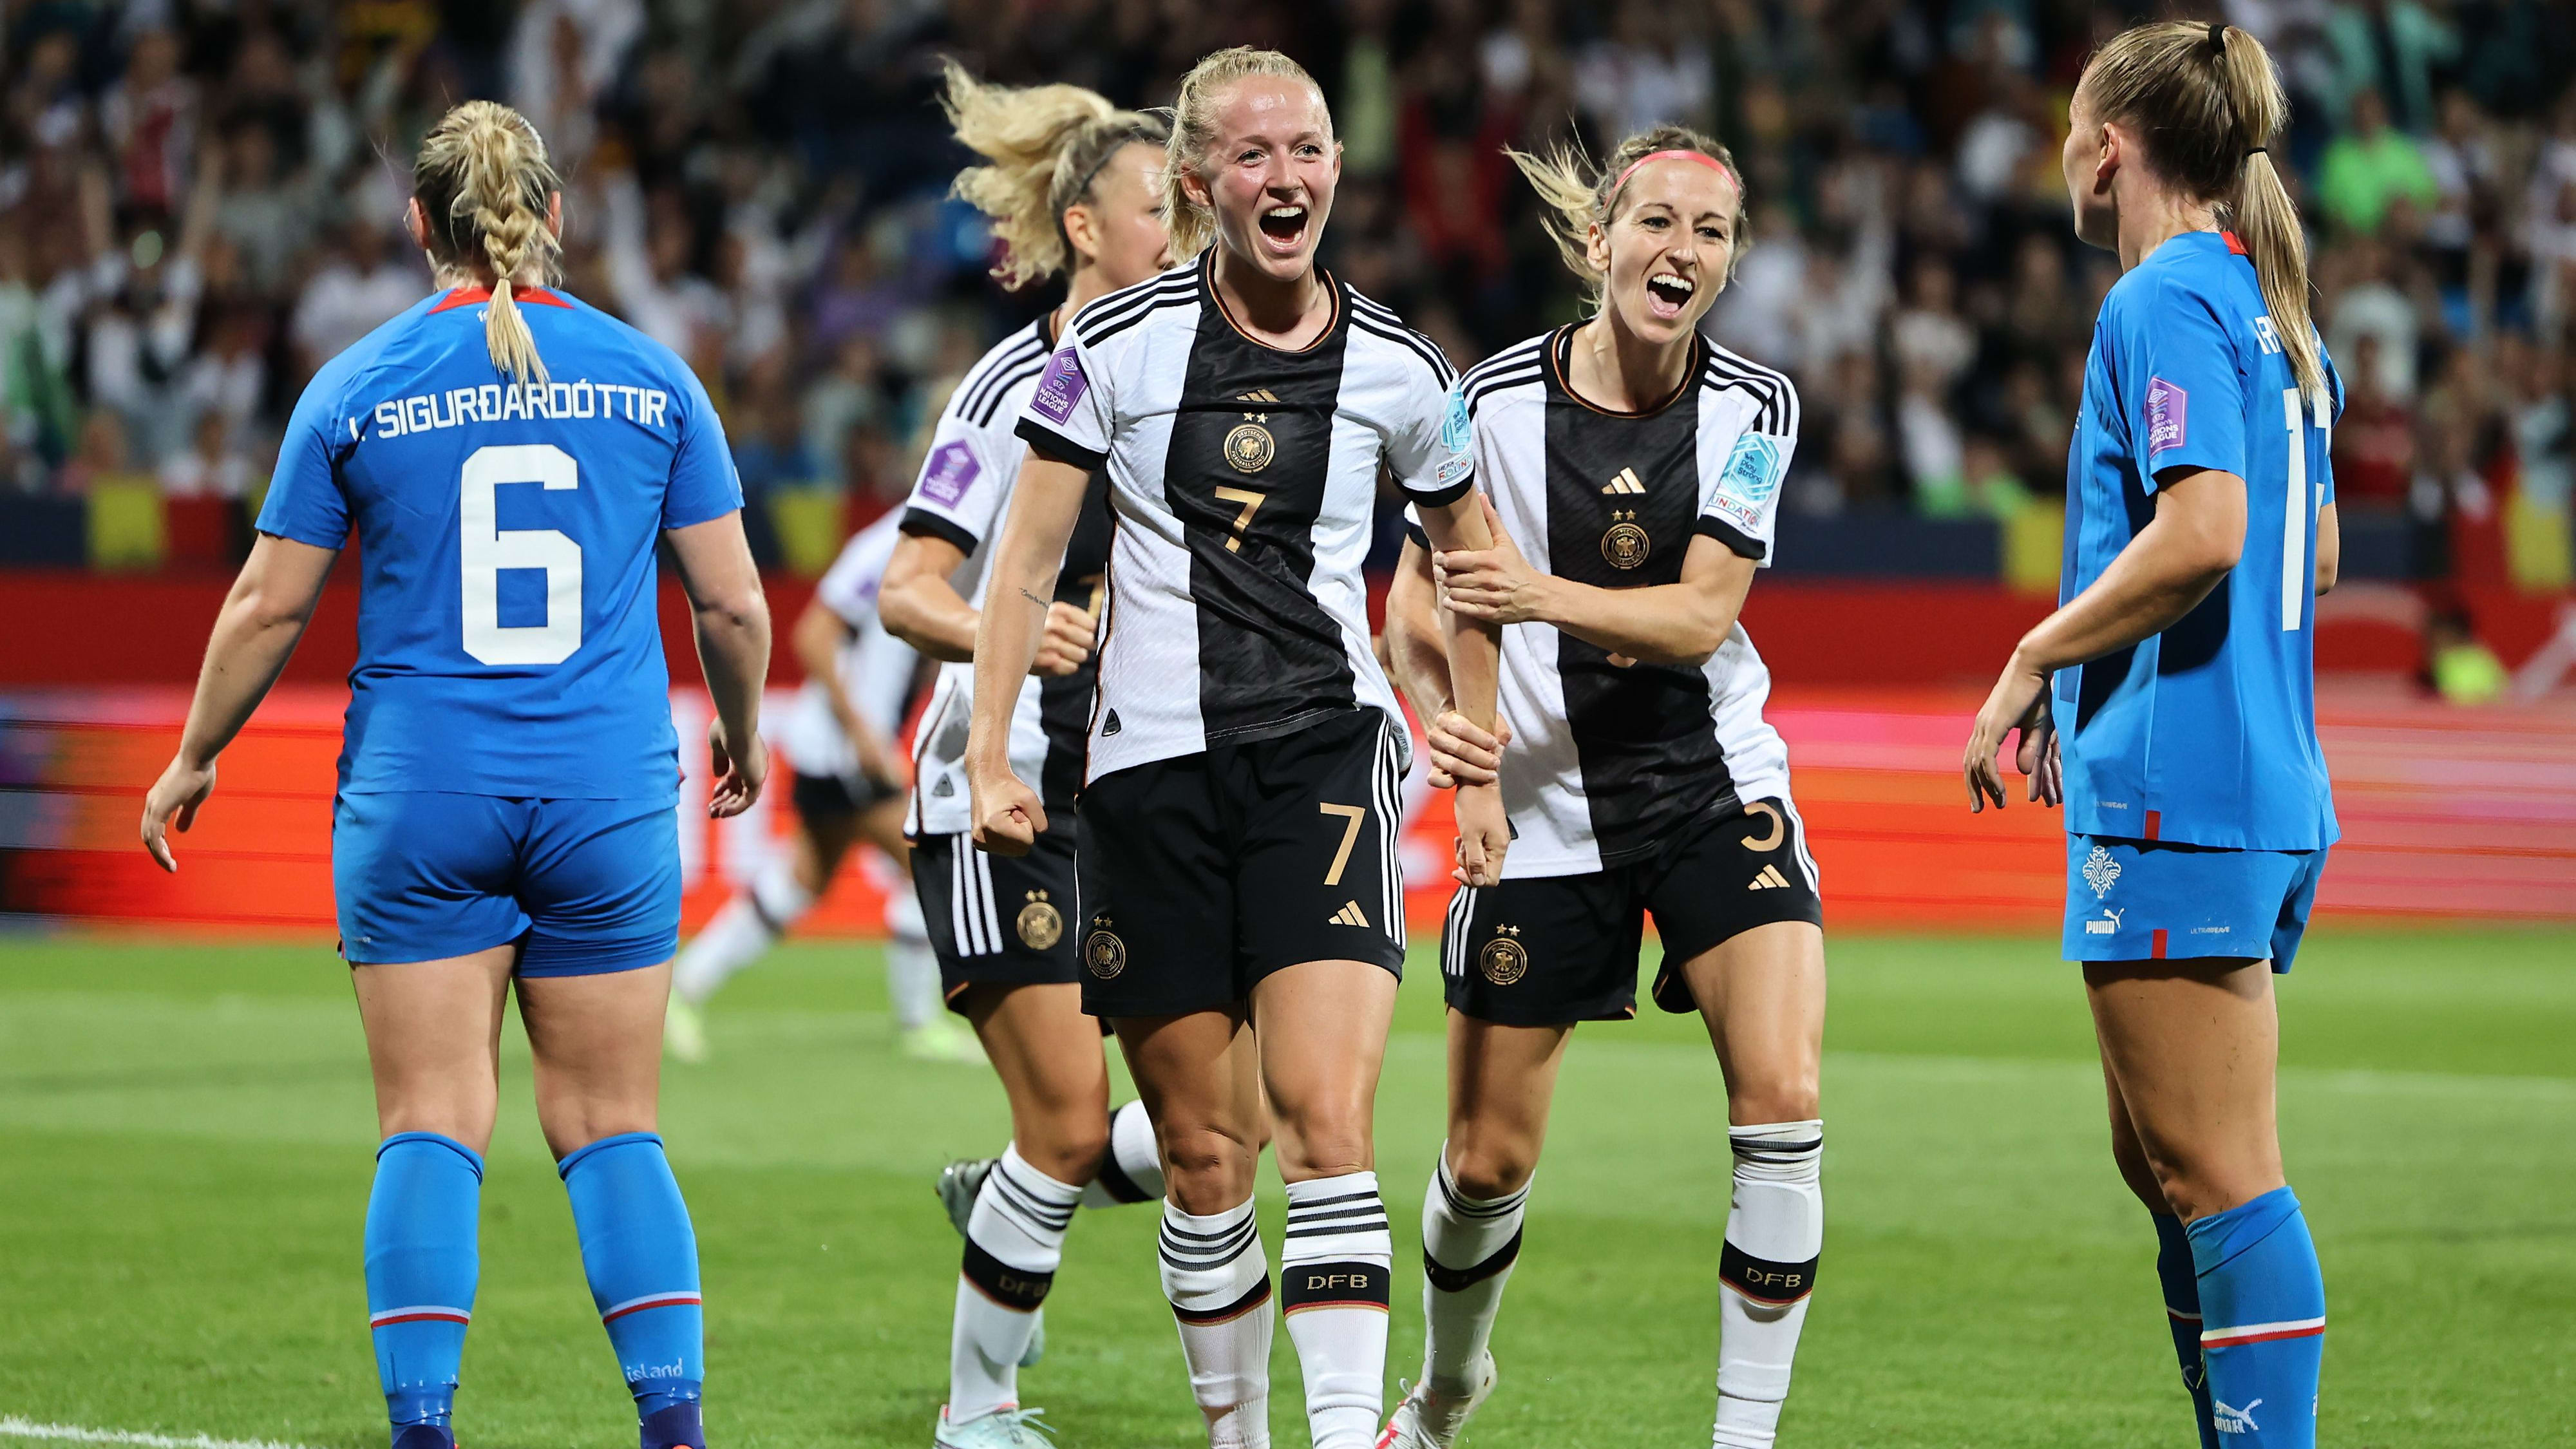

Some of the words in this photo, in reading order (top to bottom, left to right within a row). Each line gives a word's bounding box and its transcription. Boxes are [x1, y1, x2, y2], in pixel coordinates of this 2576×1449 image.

[375, 379, 667, 439] SIGURÐARDÓTTIR
[1037, 394, 1065, 414] LEAGUE
[1039, 387, 1069, 409] NATIONS
[1738, 467, 1763, 484] Strong
[1215, 486, 1266, 553] 7
[460, 444, 582, 665] 6
[1320, 802, 1366, 886] 7
[2086, 920, 2115, 934] PUMA
[1307, 1274, 1367, 1289] DFB
[1746, 1267, 1801, 1287] DFB
[627, 1358, 683, 1383] island
